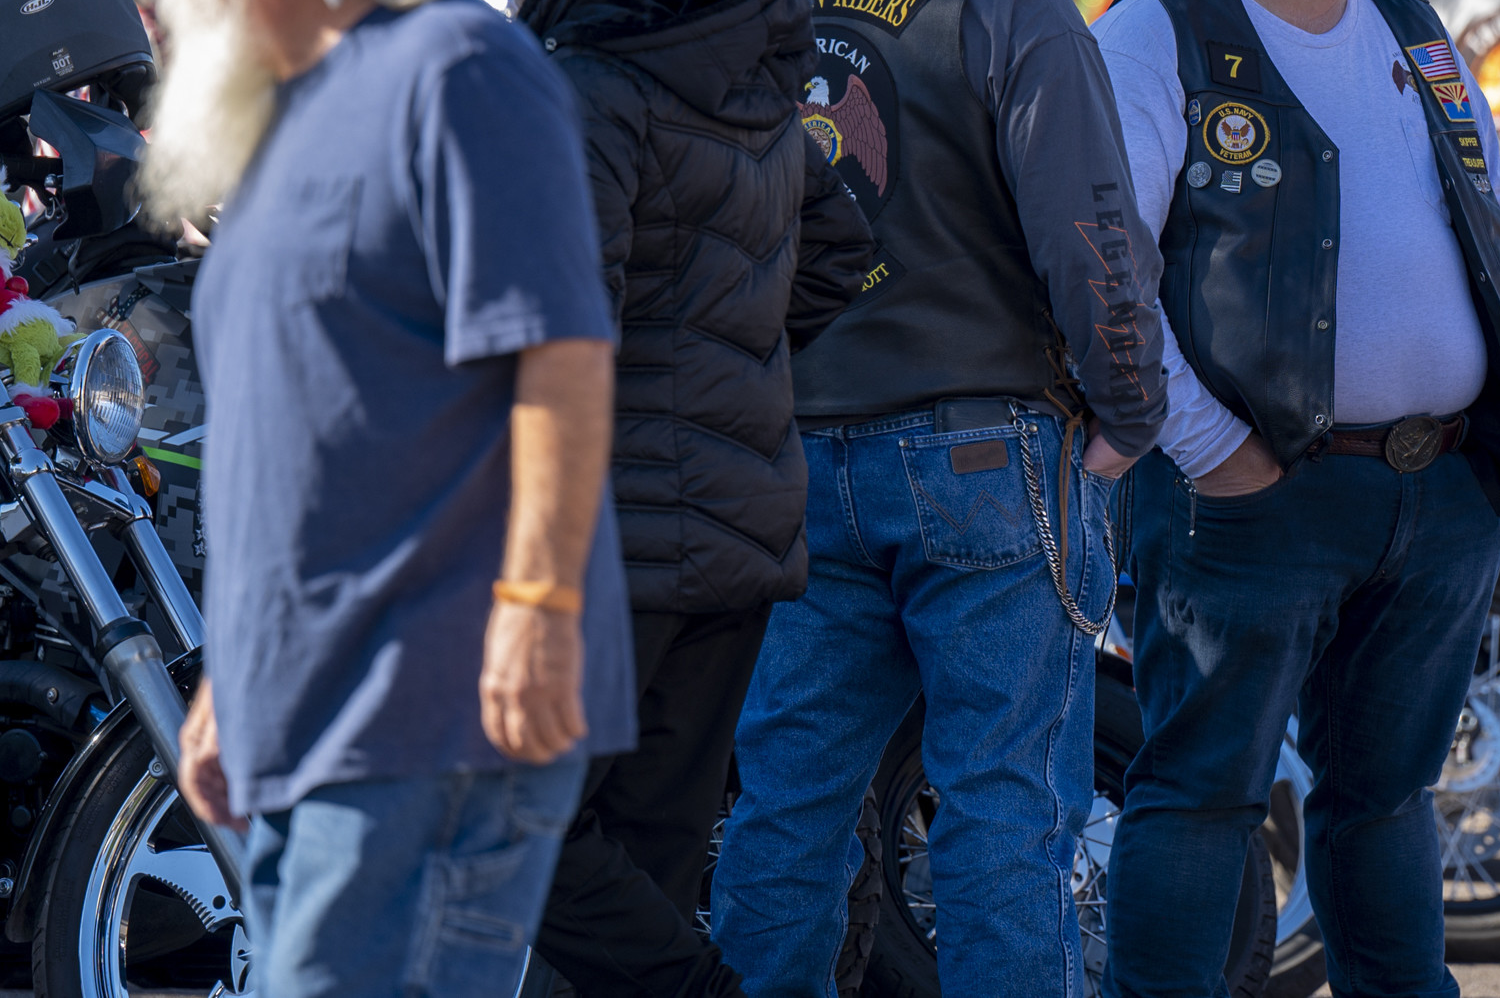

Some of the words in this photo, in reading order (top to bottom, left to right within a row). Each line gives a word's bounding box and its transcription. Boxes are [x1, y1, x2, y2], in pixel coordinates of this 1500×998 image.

[52, 55, 71, 69] DOT
[816, 37, 871, 75] RICAN
[1224, 54, 1243, 78] 7
[1218, 108, 1233, 118] U.S.
[1233, 108, 1254, 120] NAVY
[1458, 137, 1478, 147] SKIPPER
[1219, 149, 1253, 160] VETERAN
